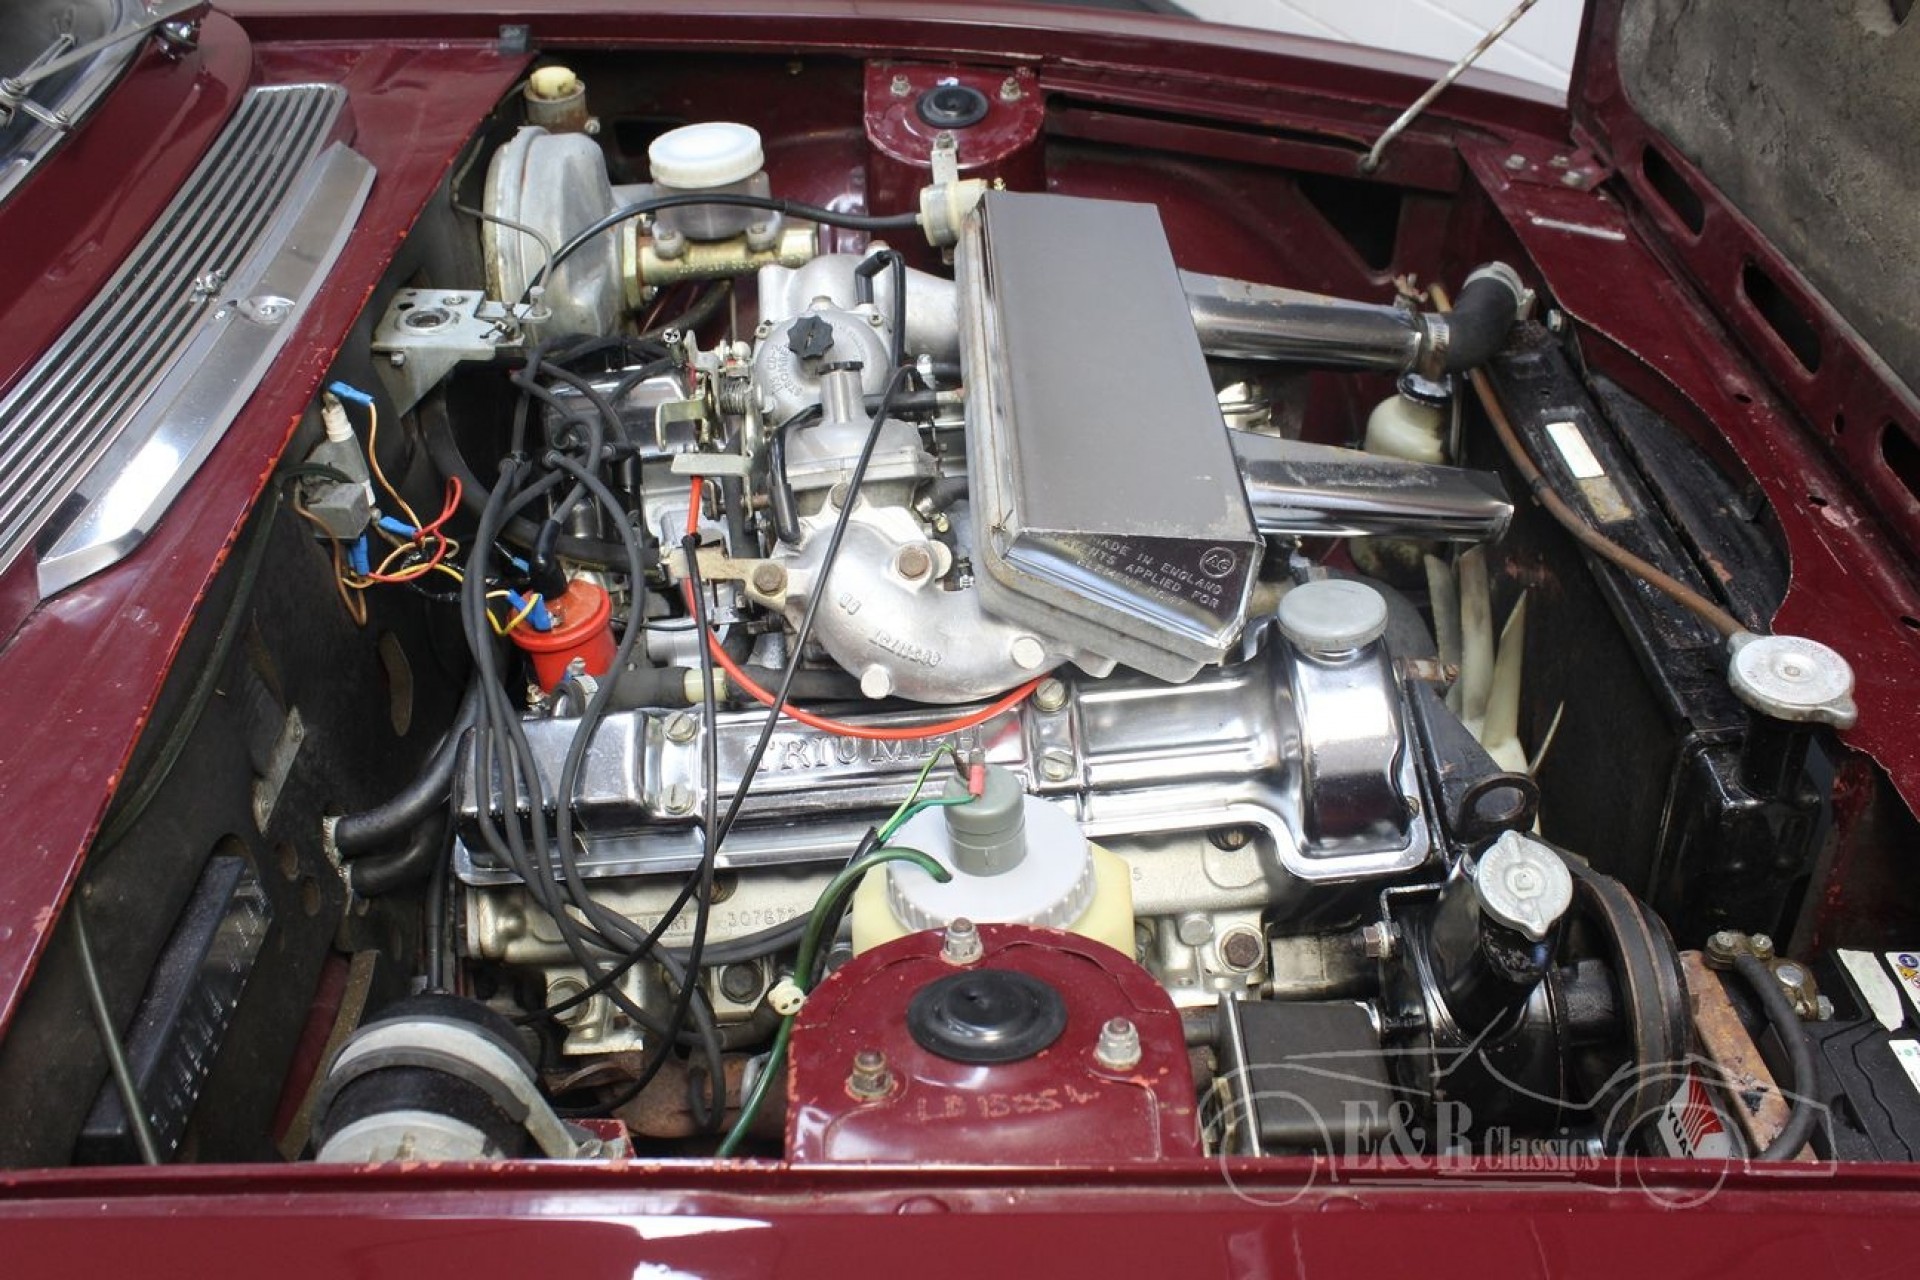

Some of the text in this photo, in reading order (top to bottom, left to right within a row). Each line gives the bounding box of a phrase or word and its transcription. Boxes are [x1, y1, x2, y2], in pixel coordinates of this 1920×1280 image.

[1125, 564, 1182, 592] APPLIED
[1191, 590, 1220, 608] FOR
[1137, 553, 1154, 565] IN
[1160, 563, 1223, 595] ENGLAND
[746, 725, 984, 772] TRIUMPH
